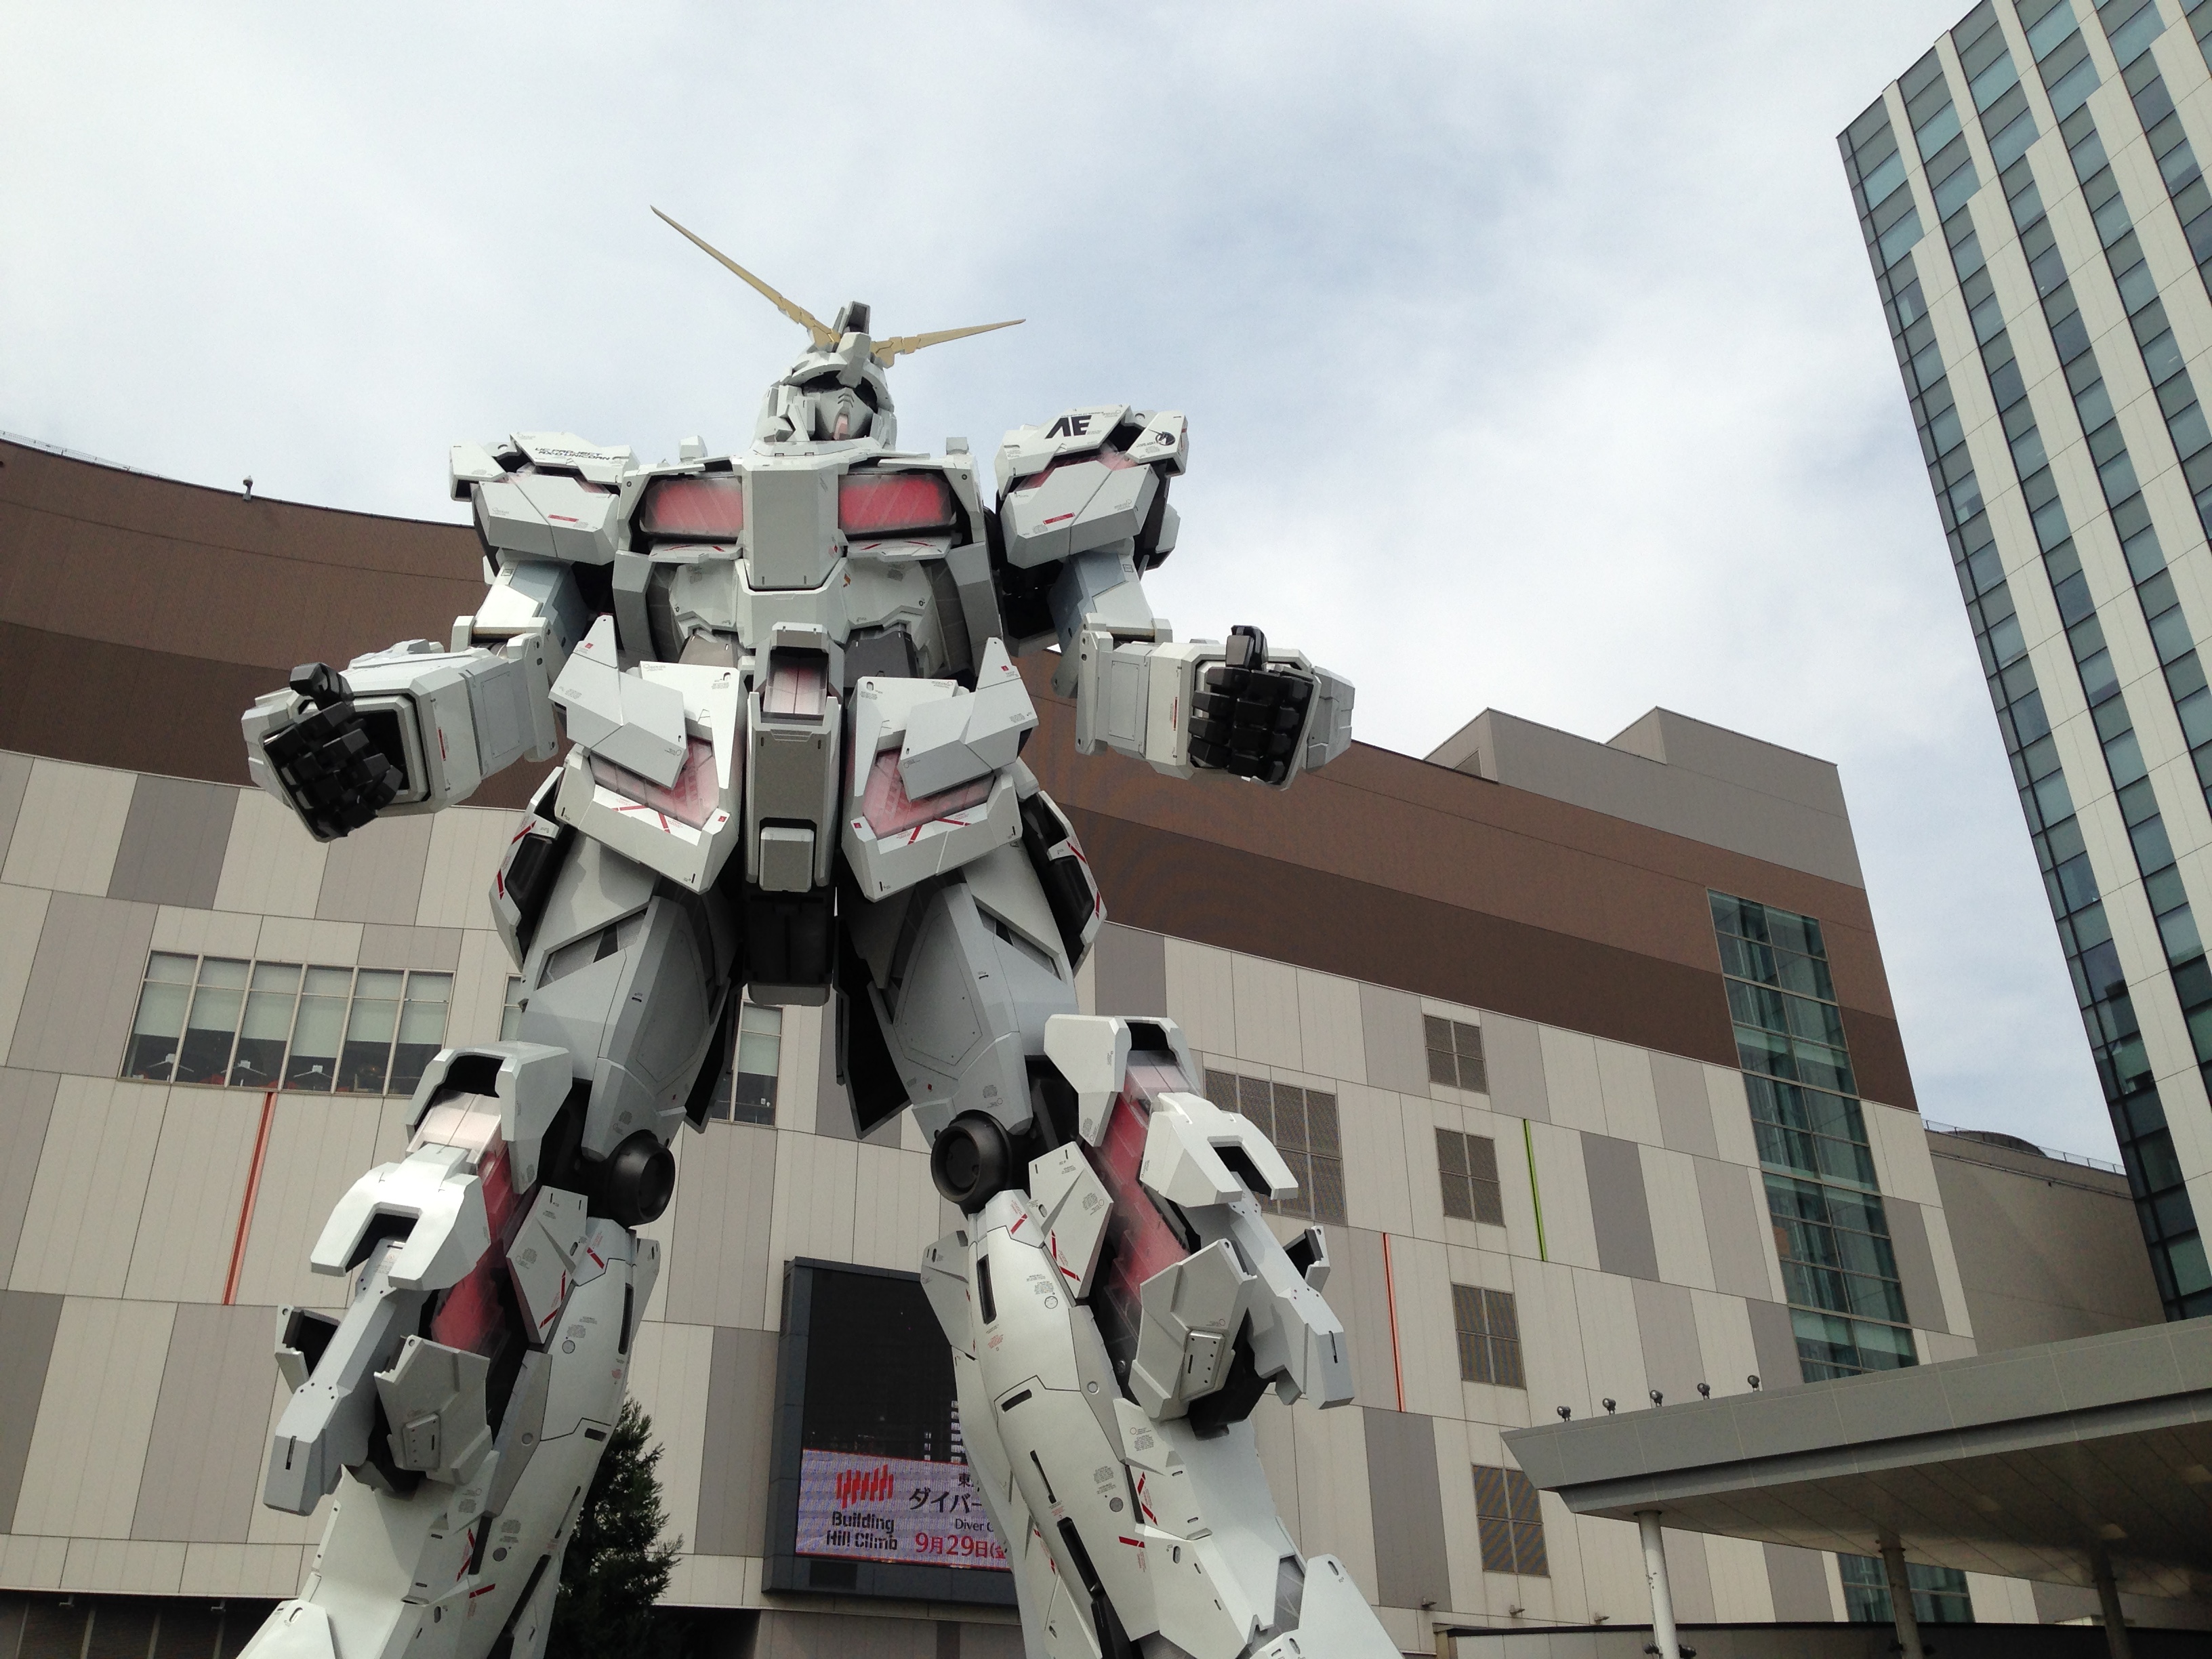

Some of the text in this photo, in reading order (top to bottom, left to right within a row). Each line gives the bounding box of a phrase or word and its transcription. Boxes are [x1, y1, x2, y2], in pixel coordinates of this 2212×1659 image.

[958, 1473, 975, 1488] 東
[909, 1487, 983, 1513] ダイバー
[832, 1511, 895, 1534] Building
[955, 1518, 984, 1532] Diver
[855, 1532, 898, 1550] Climb
